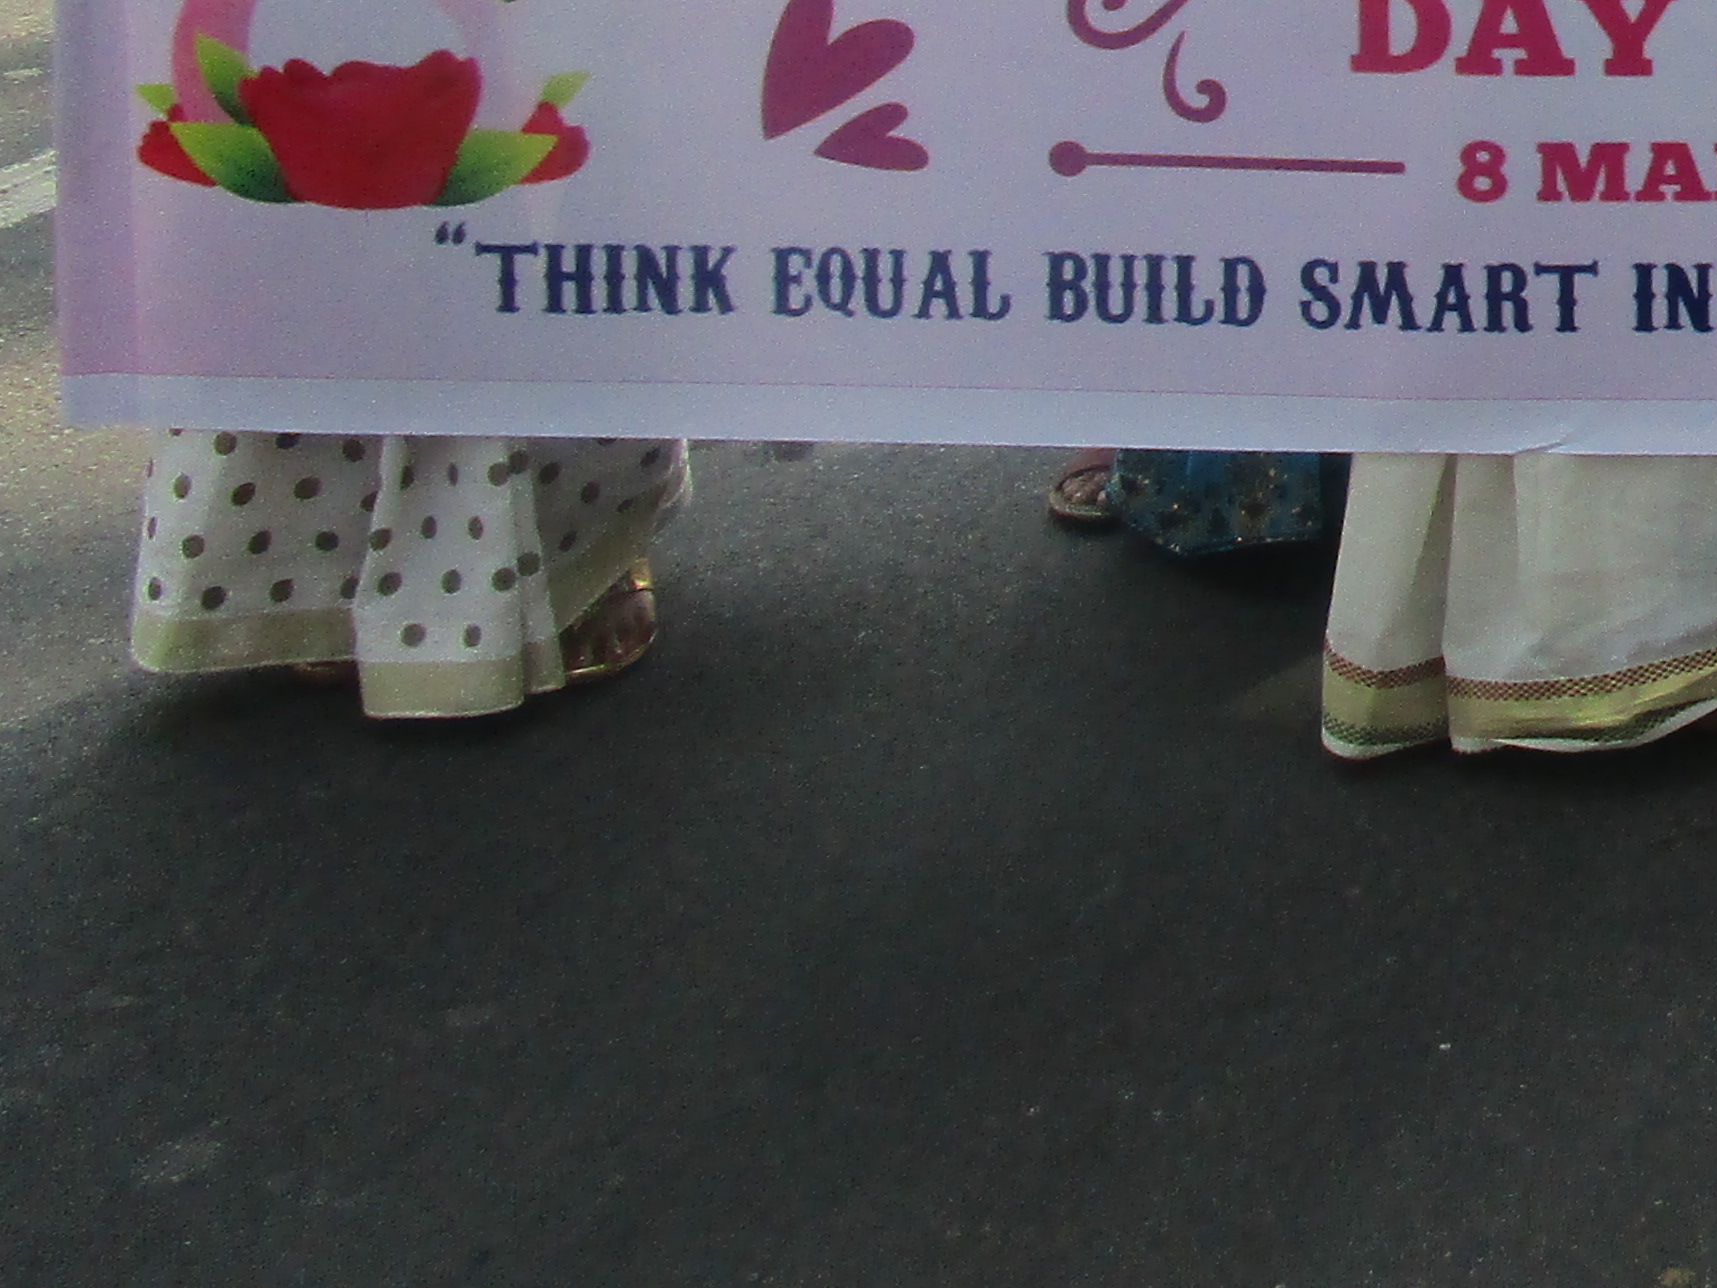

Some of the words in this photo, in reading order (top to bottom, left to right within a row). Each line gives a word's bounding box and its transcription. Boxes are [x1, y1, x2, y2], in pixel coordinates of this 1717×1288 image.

[1456, 139, 1509, 204] 8
[772, 245, 1012, 321] EQUAL
[1046, 251, 1267, 328] BUILD
[1299, 258, 1599, 334] SMART
